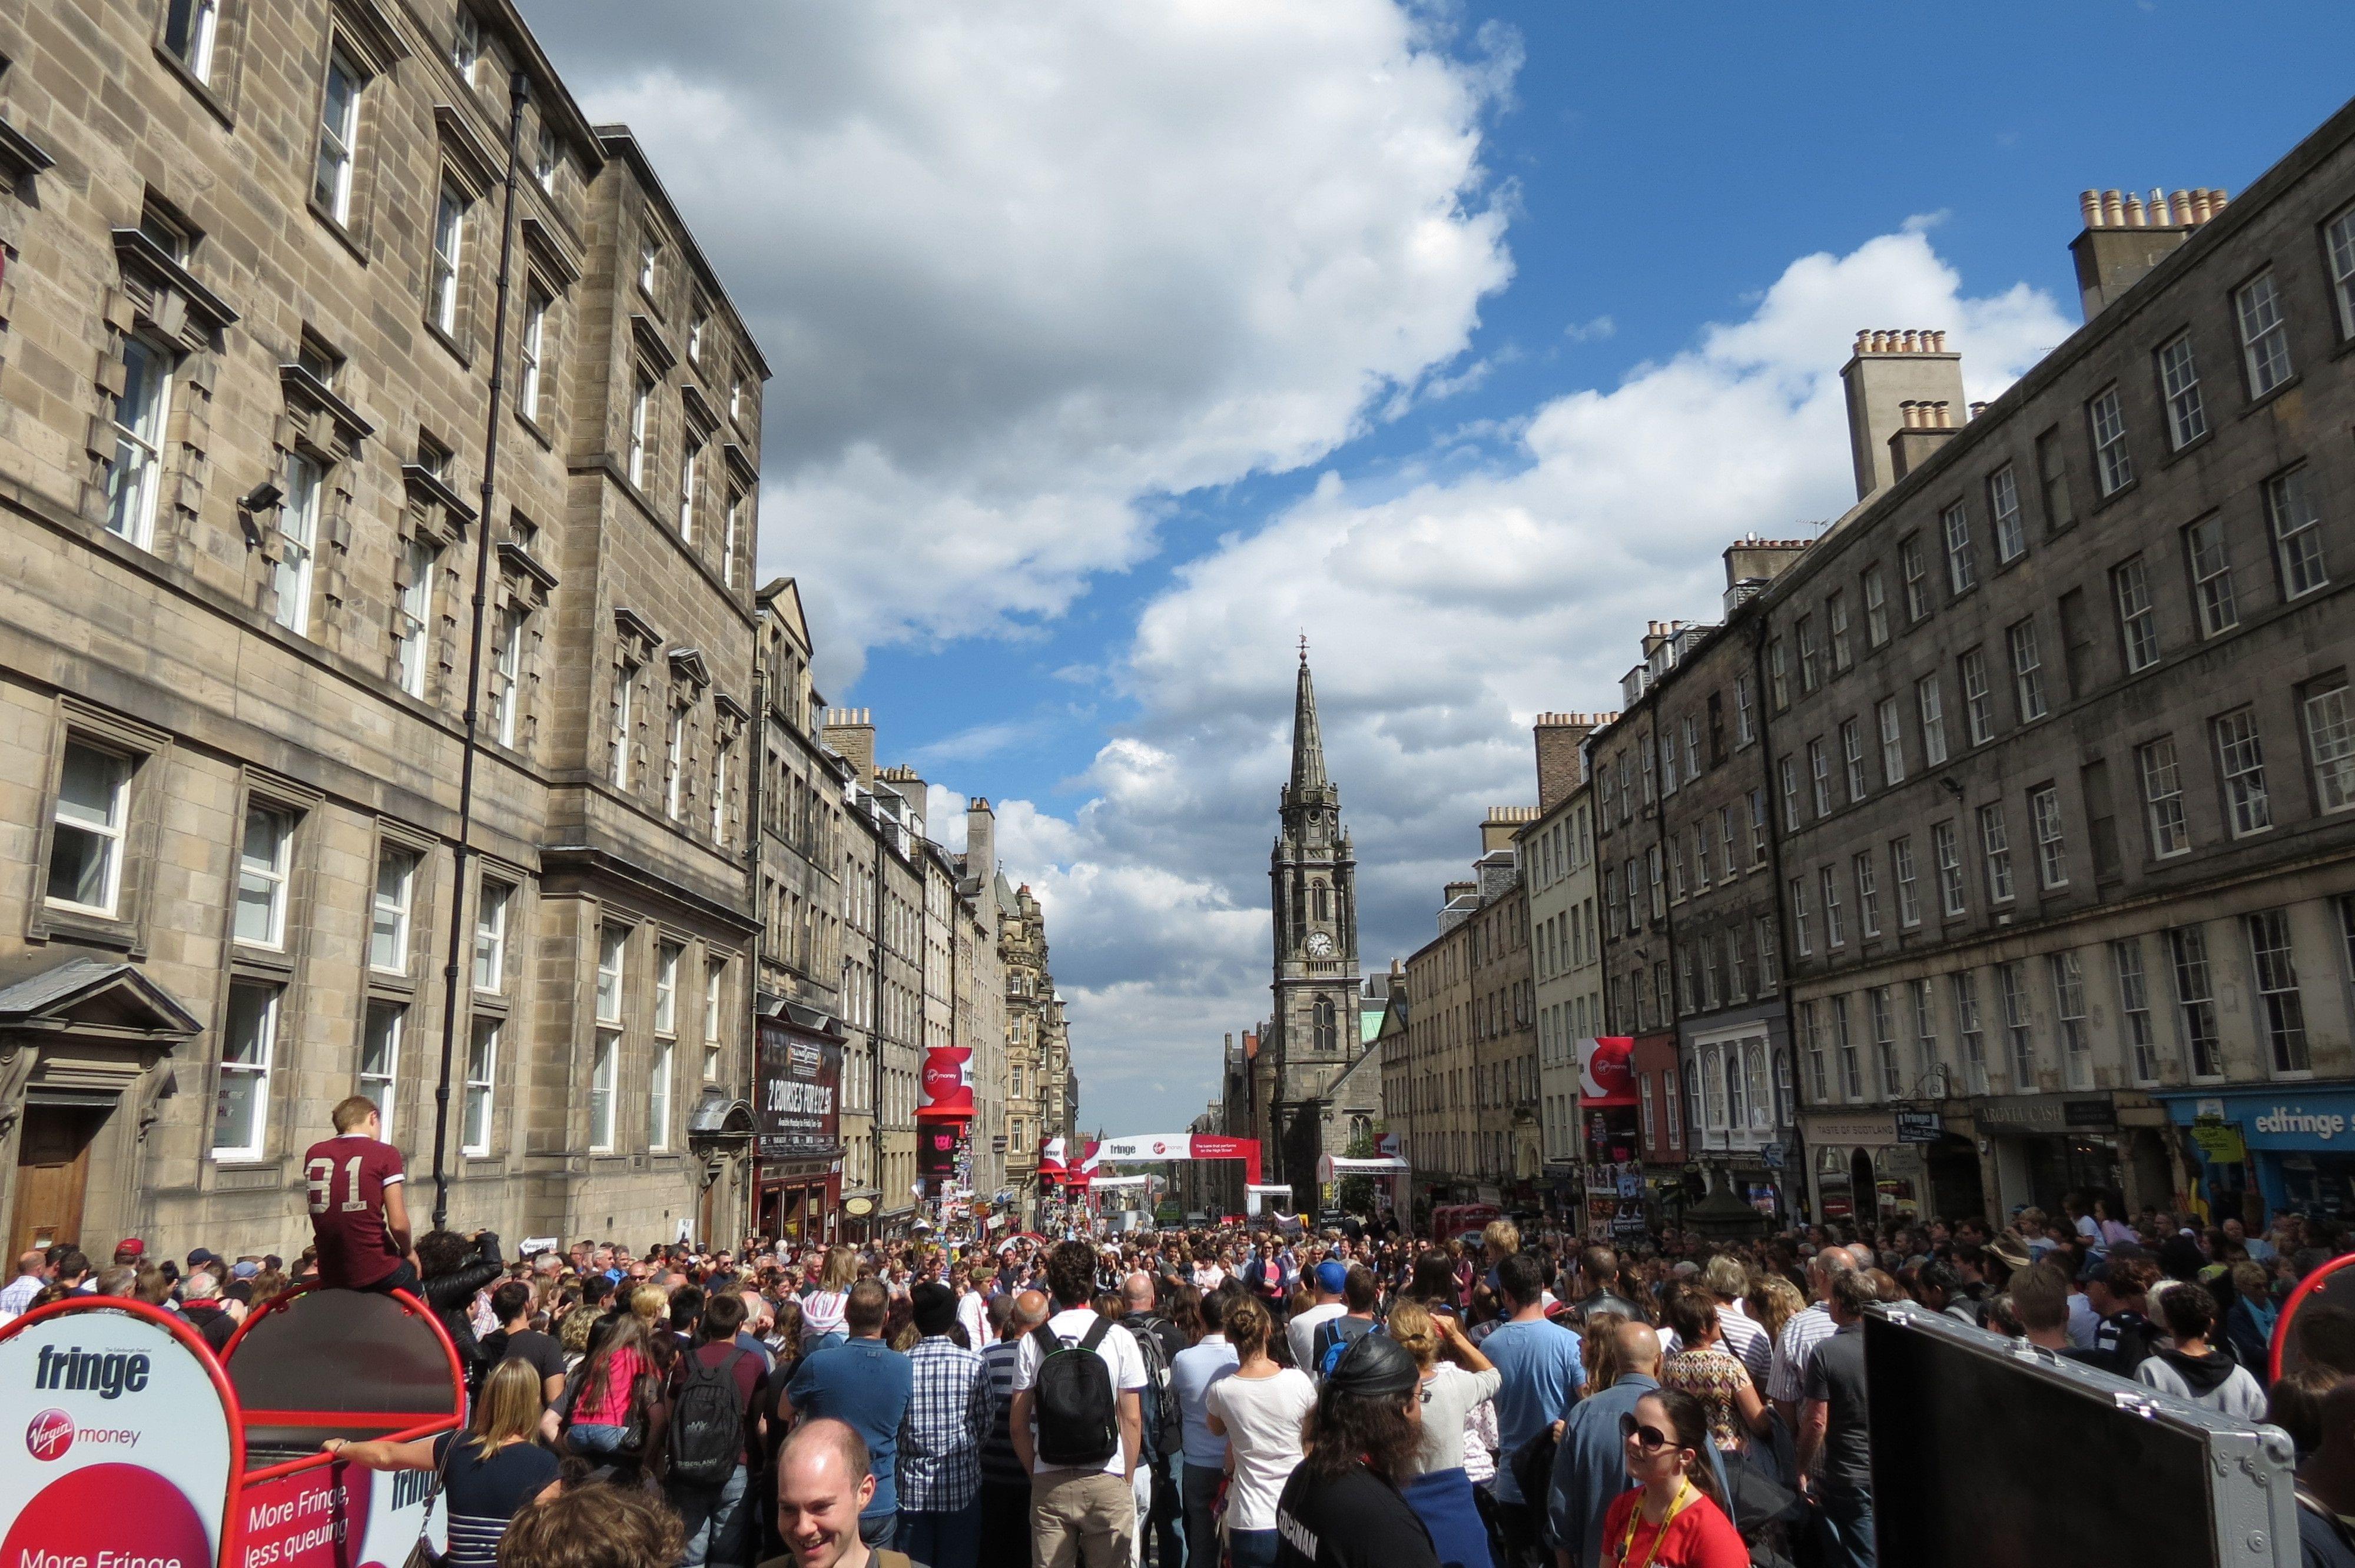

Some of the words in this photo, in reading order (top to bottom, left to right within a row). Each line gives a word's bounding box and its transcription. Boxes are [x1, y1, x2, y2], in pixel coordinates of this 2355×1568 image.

[767, 1078, 774, 1111] 2
[774, 1079, 804, 1112] COURSES
[803, 1084, 814, 1114] FOR
[1818, 1126, 1840, 1134] TASTE
[1842, 1125, 1850, 1134] OF
[1853, 1125, 1893, 1135] SCOTLAND
[1901, 1126, 1921, 1137] Ticket
[1922, 1129, 1941, 1138] Sales
[1904, 1113, 1931, 1125] fringe
[1982, 1107, 2024, 1122] ARGYLL
[2256, 1106, 2344, 1140] edfringe
[1110, 1144, 1136, 1155] fringe
[35, 1344, 151, 1400] fringe
[29, 1413, 73, 1455] Virgin
[77, 1427, 142, 1449] money
[391, 1469, 446, 1511] fring
[248, 1502, 294, 1533] More
[298, 1484, 350, 1515] Fringe,
[244, 1543, 280, 1568] less
[284, 1516, 349, 1563] queuing
[1278, 1507, 1318, 1562] STICKMAN
[21, 1548, 88, 1568] More
